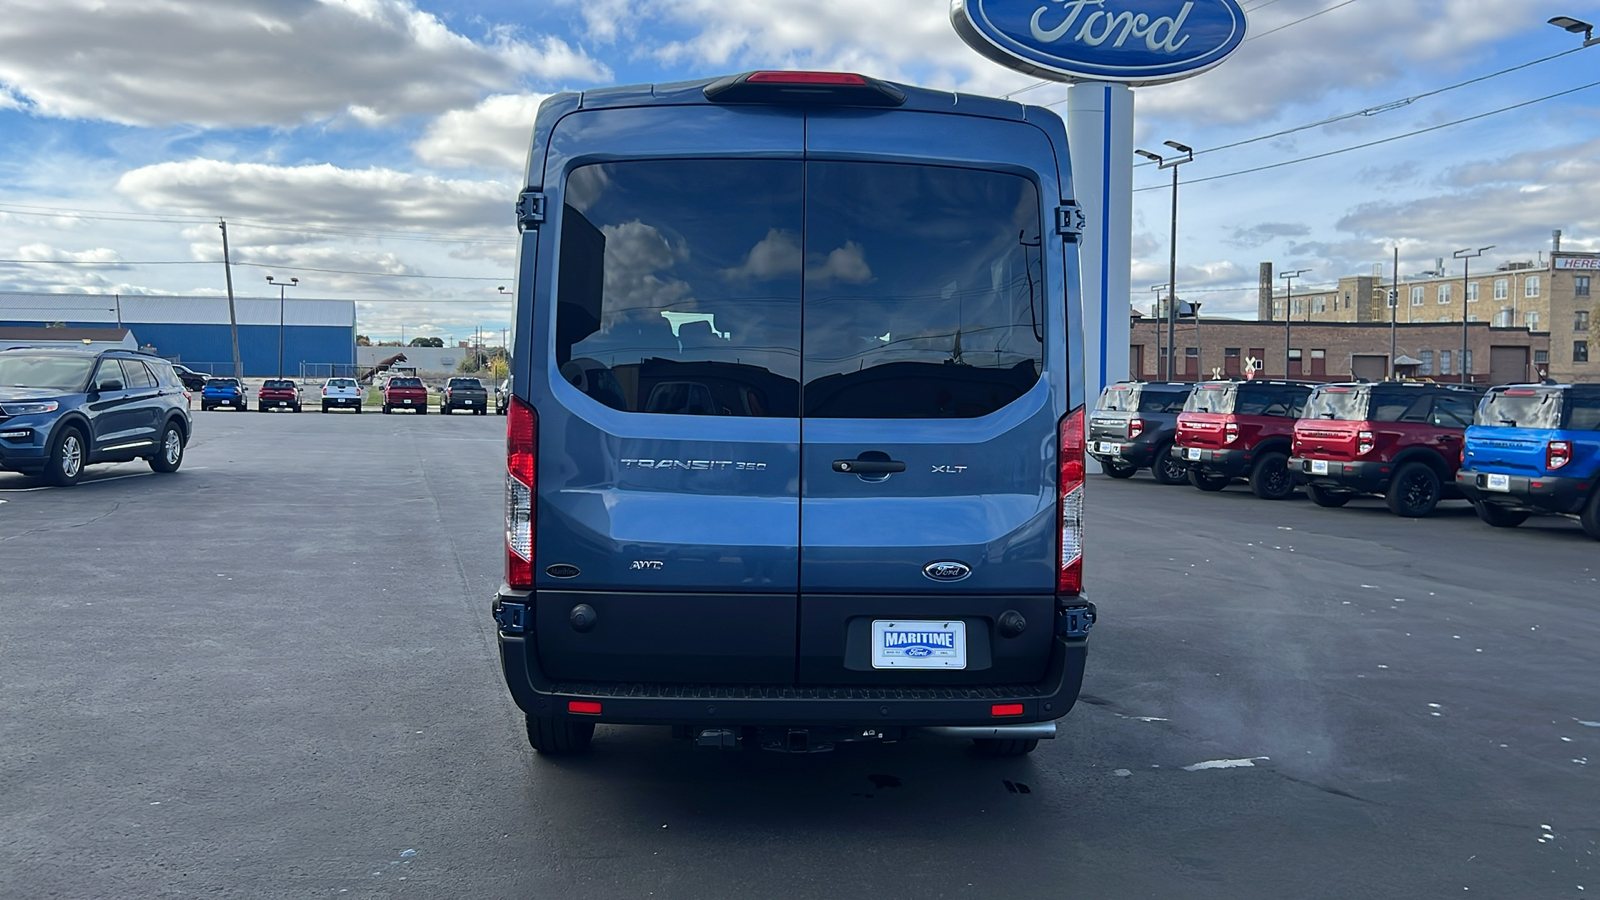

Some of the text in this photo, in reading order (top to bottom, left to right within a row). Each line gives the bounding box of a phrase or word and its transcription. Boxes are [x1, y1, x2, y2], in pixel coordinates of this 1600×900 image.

[1030, 0, 1194, 53] Ford
[620, 458, 767, 471] TRANSIT 350
[931, 465, 968, 473] XLT
[629, 560, 664, 570] AWD
[935, 565, 961, 576] Ford
[885, 632, 953, 648] MARITIME
[908, 648, 928, 656] Ford
